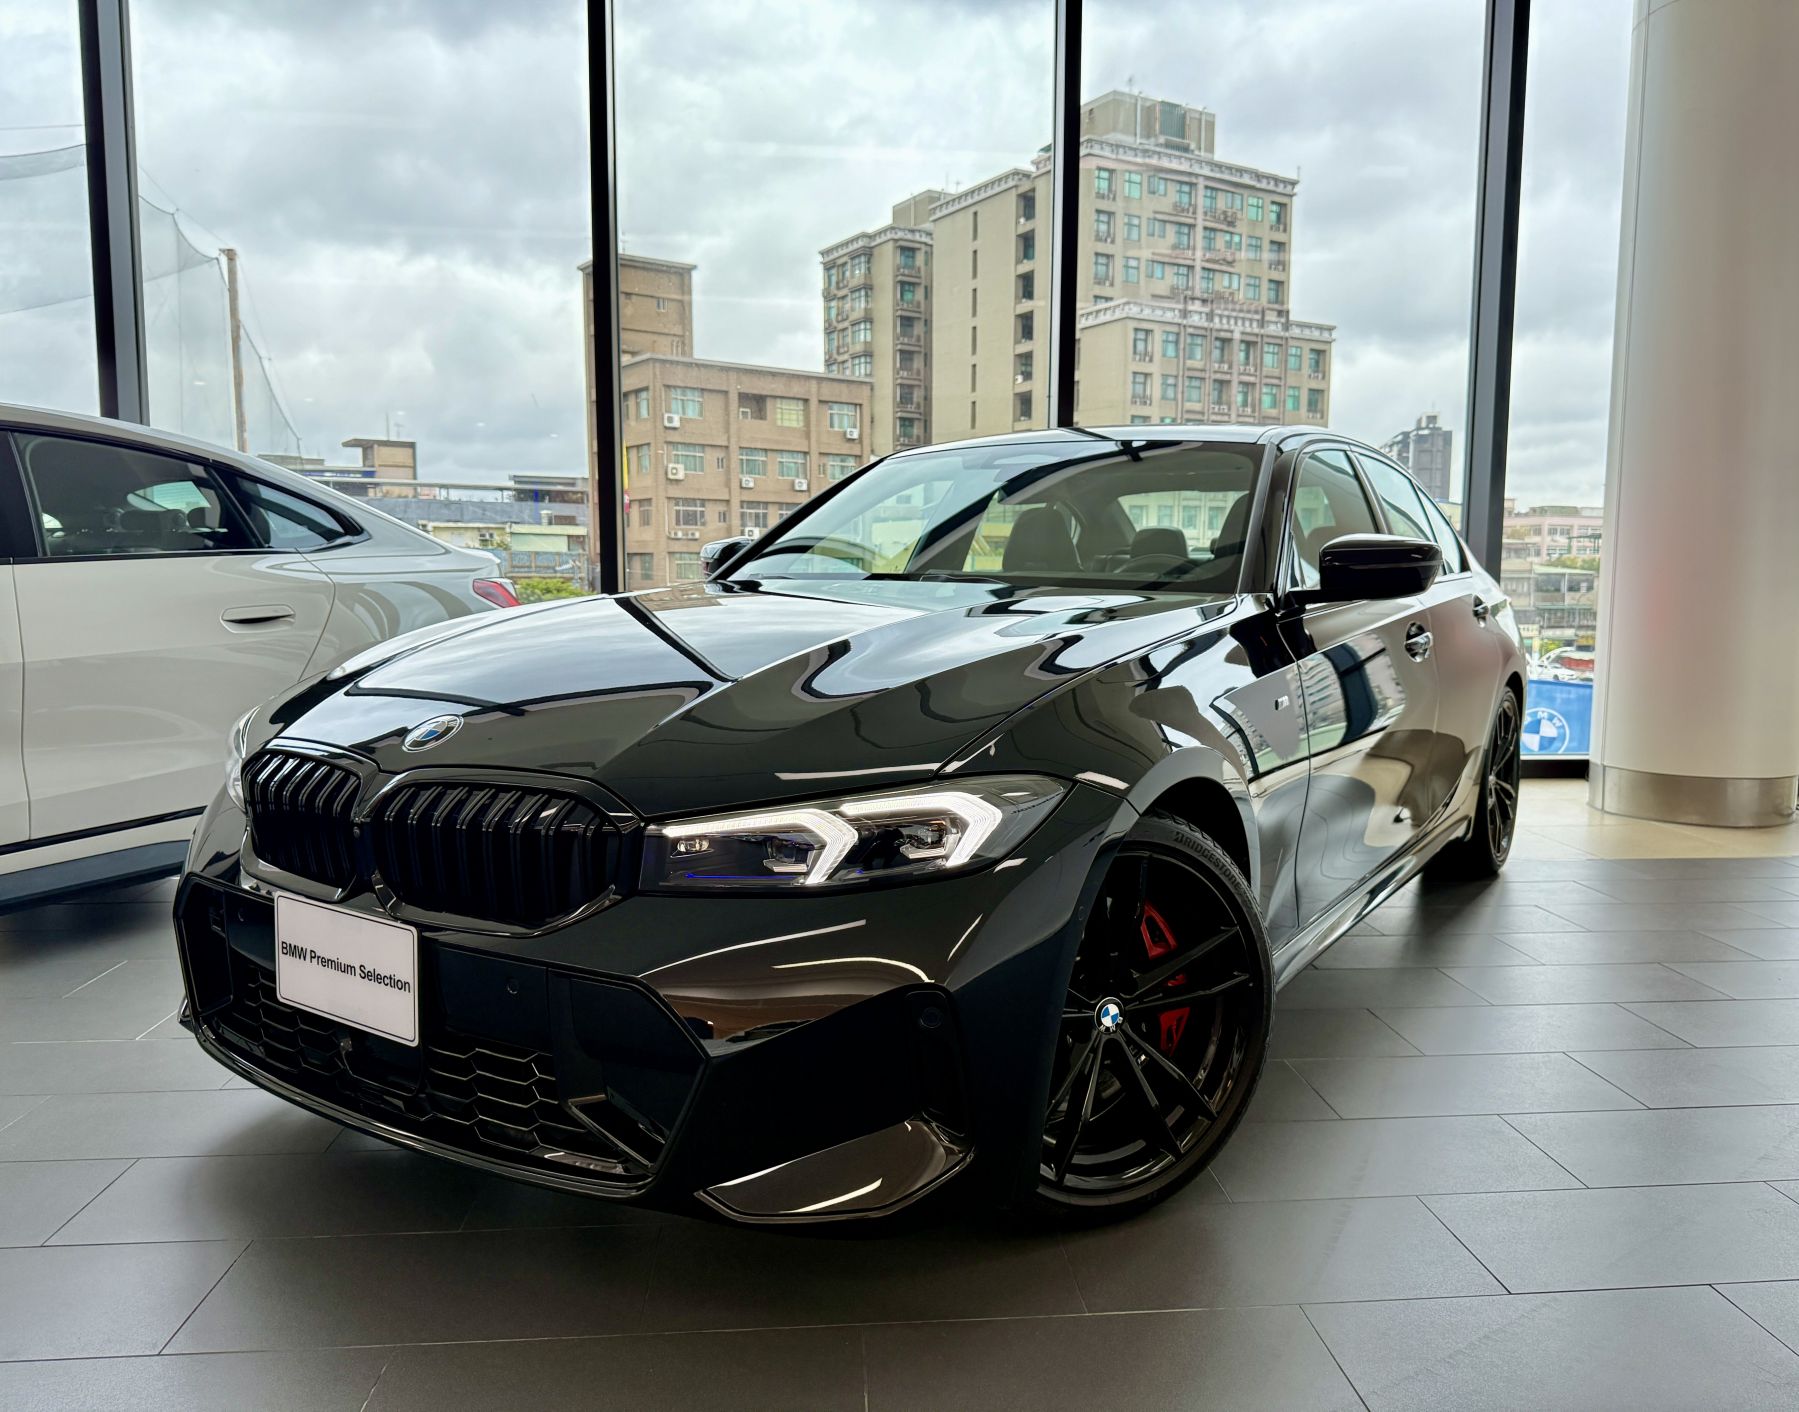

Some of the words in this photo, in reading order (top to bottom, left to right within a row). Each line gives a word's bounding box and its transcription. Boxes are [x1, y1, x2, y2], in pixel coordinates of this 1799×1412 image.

[281, 940, 307, 962] BMW
[309, 949, 357, 977] Premium
[358, 964, 411, 993] Selection
